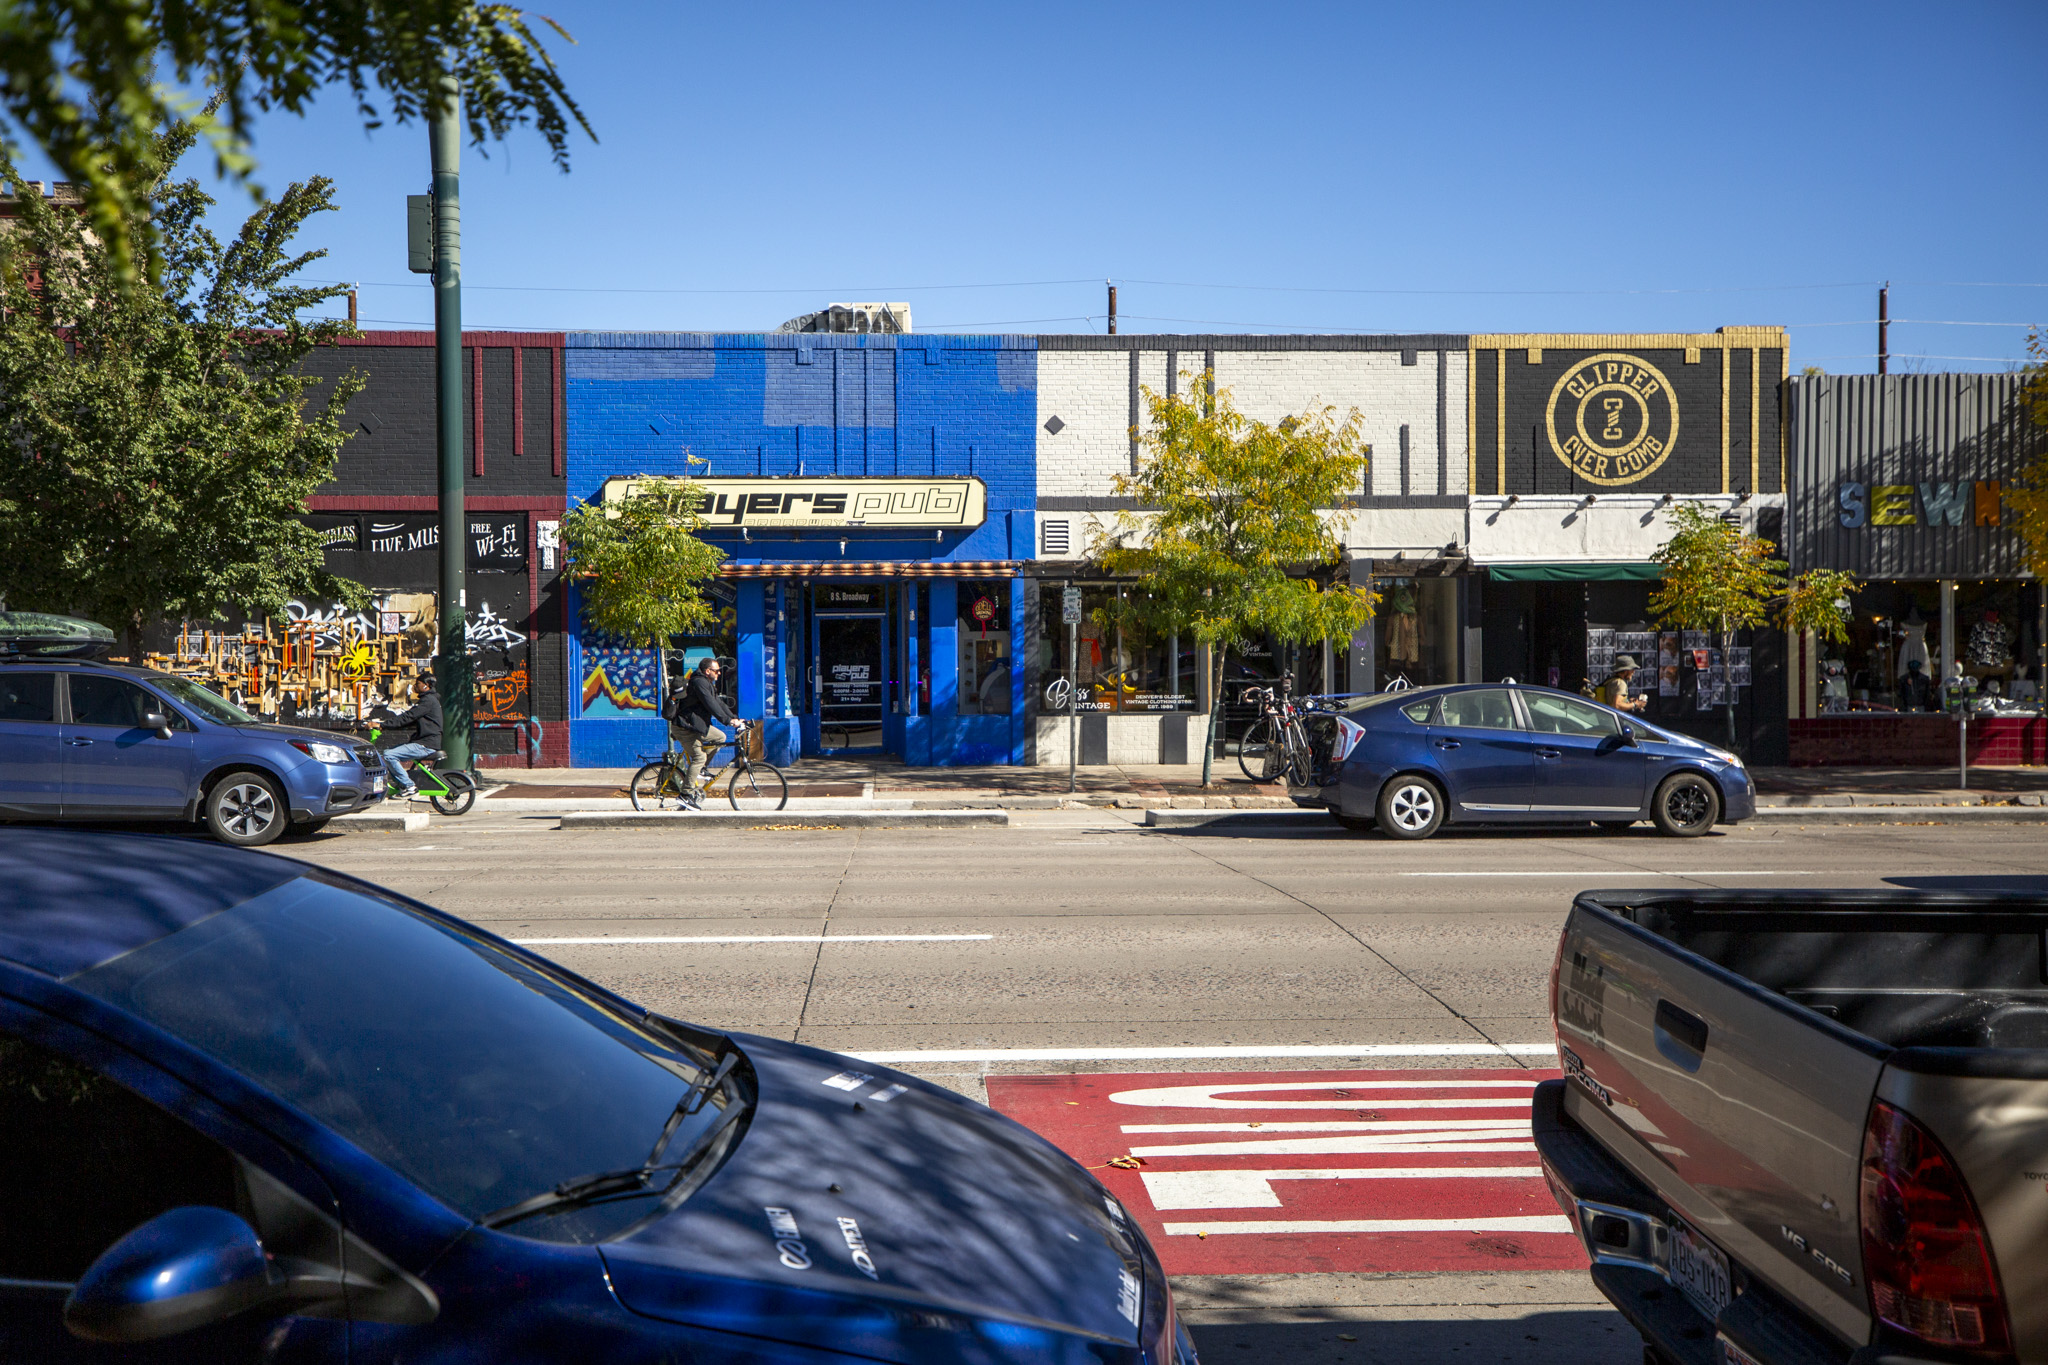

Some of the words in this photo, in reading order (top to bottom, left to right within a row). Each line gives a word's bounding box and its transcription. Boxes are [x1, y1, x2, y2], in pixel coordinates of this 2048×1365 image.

[1566, 362, 1660, 400] CLIPPER
[1562, 435, 1608, 478] OVER
[1615, 435, 1663, 476] COMB
[853, 488, 963, 518] pub
[1840, 481, 2001, 528] SEWN
[408, 524, 439, 551] MUS
[470, 523, 492, 534] FREE
[475, 523, 517, 558] Wi-Fi
[842, 592, 870, 603] Broadway
[832, 664, 870, 673] players
[850, 672, 870, 681] pub
[1046, 676, 1090, 709] Bss
[1566, 1060, 1613, 1106] TACOMA
[1781, 1224, 1806, 1250] V6
